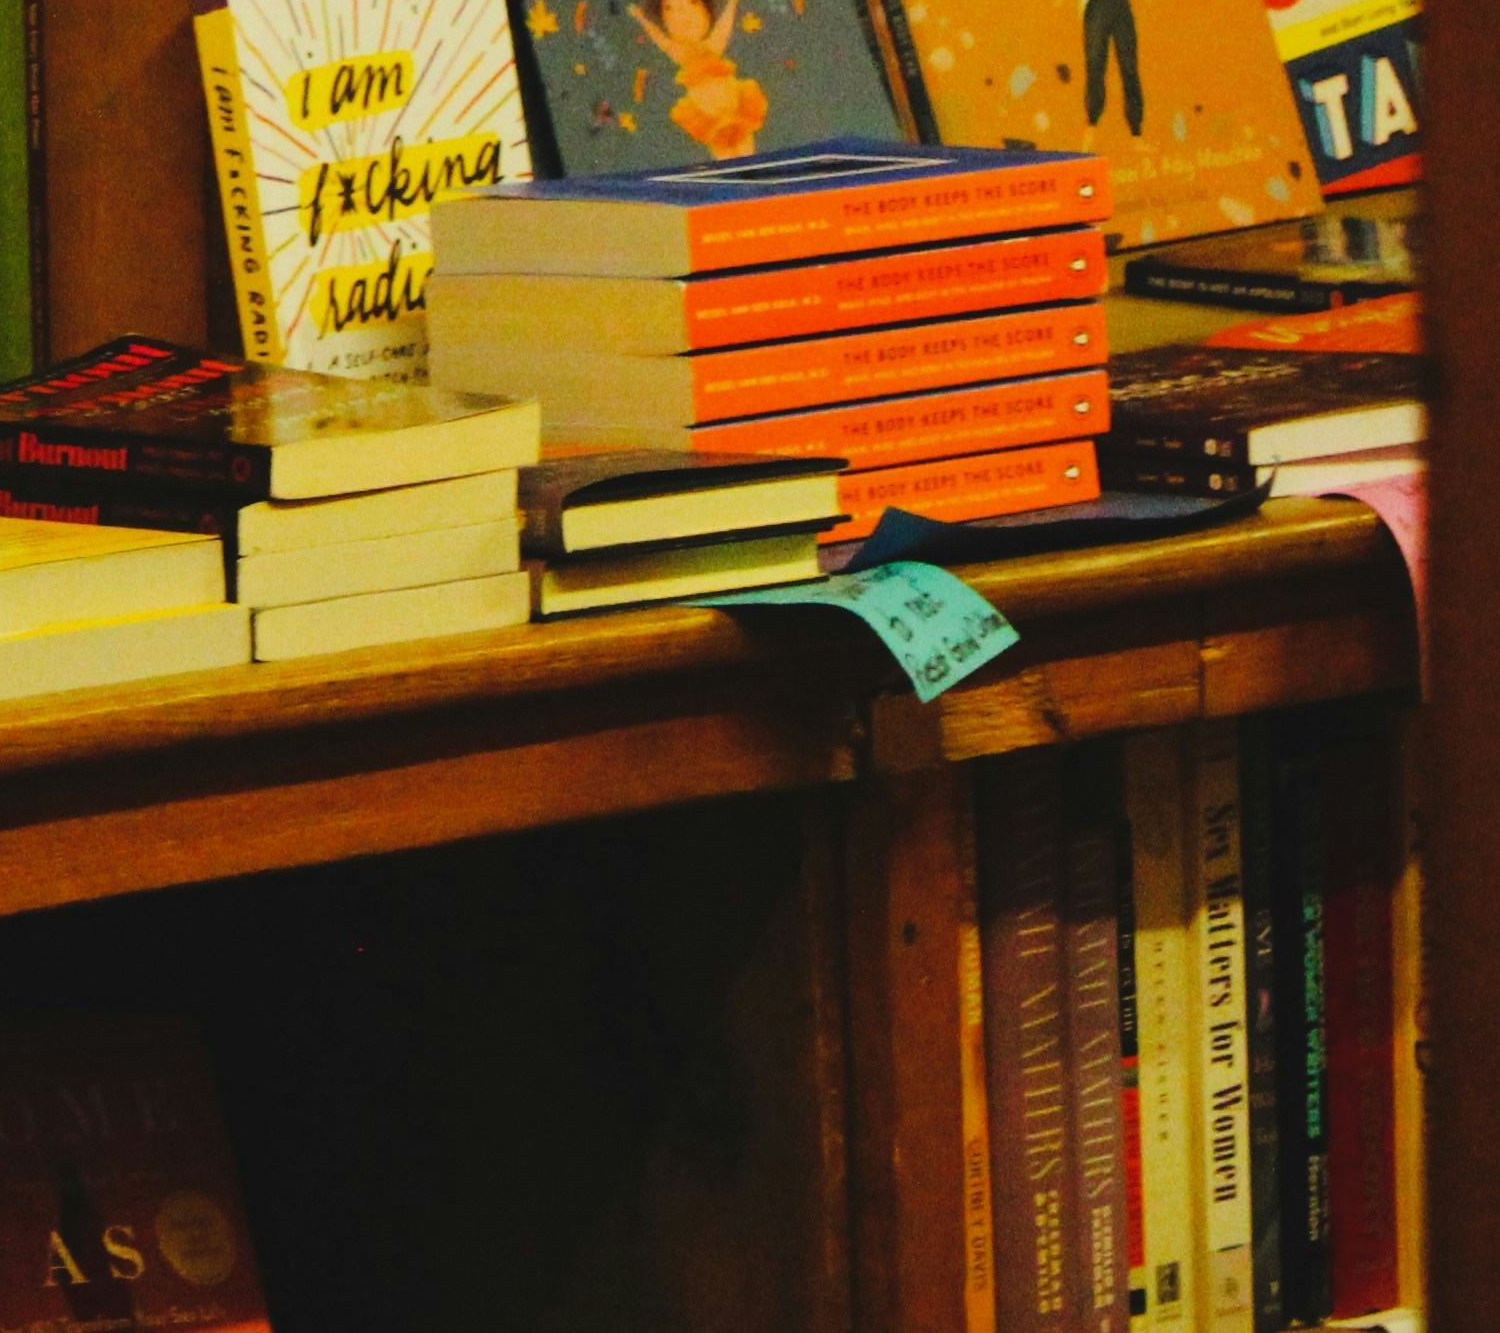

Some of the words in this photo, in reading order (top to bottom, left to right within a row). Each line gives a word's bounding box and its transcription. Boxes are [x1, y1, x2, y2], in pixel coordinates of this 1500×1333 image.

[330, 62, 404, 115] am
[843, 199, 874, 219] THE
[878, 195, 915, 215] BODY
[922, 189, 968, 212] KEEPS
[974, 185, 1004, 204] THE
[1008, 178, 1057, 200] SCORE
[1208, 1024, 1238, 1070] for
[1212, 1084, 1243, 1204] Women
